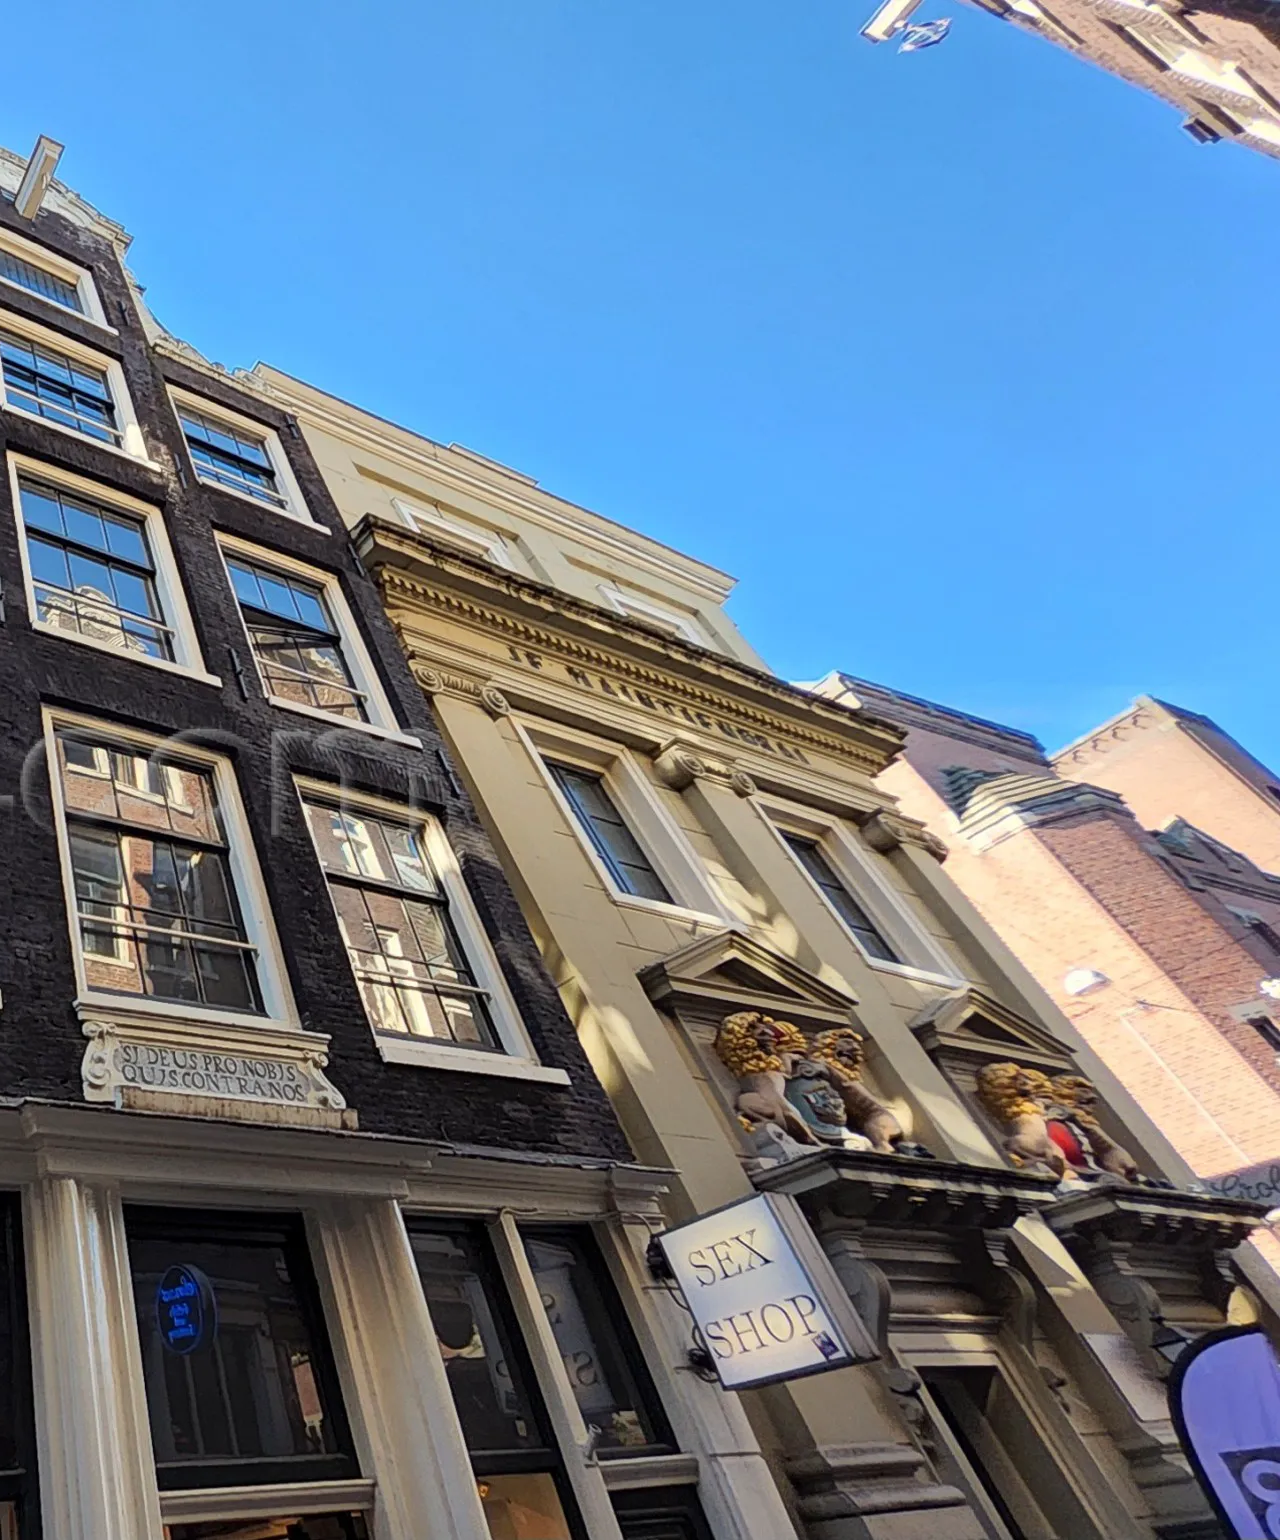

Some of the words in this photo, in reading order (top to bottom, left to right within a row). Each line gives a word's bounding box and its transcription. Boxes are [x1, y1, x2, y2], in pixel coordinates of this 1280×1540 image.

[147, 1048, 199, 1071] DEUS
[202, 1054, 238, 1075] PRO
[688, 1228, 775, 1288] SEX
[704, 1294, 819, 1360] SHOP
